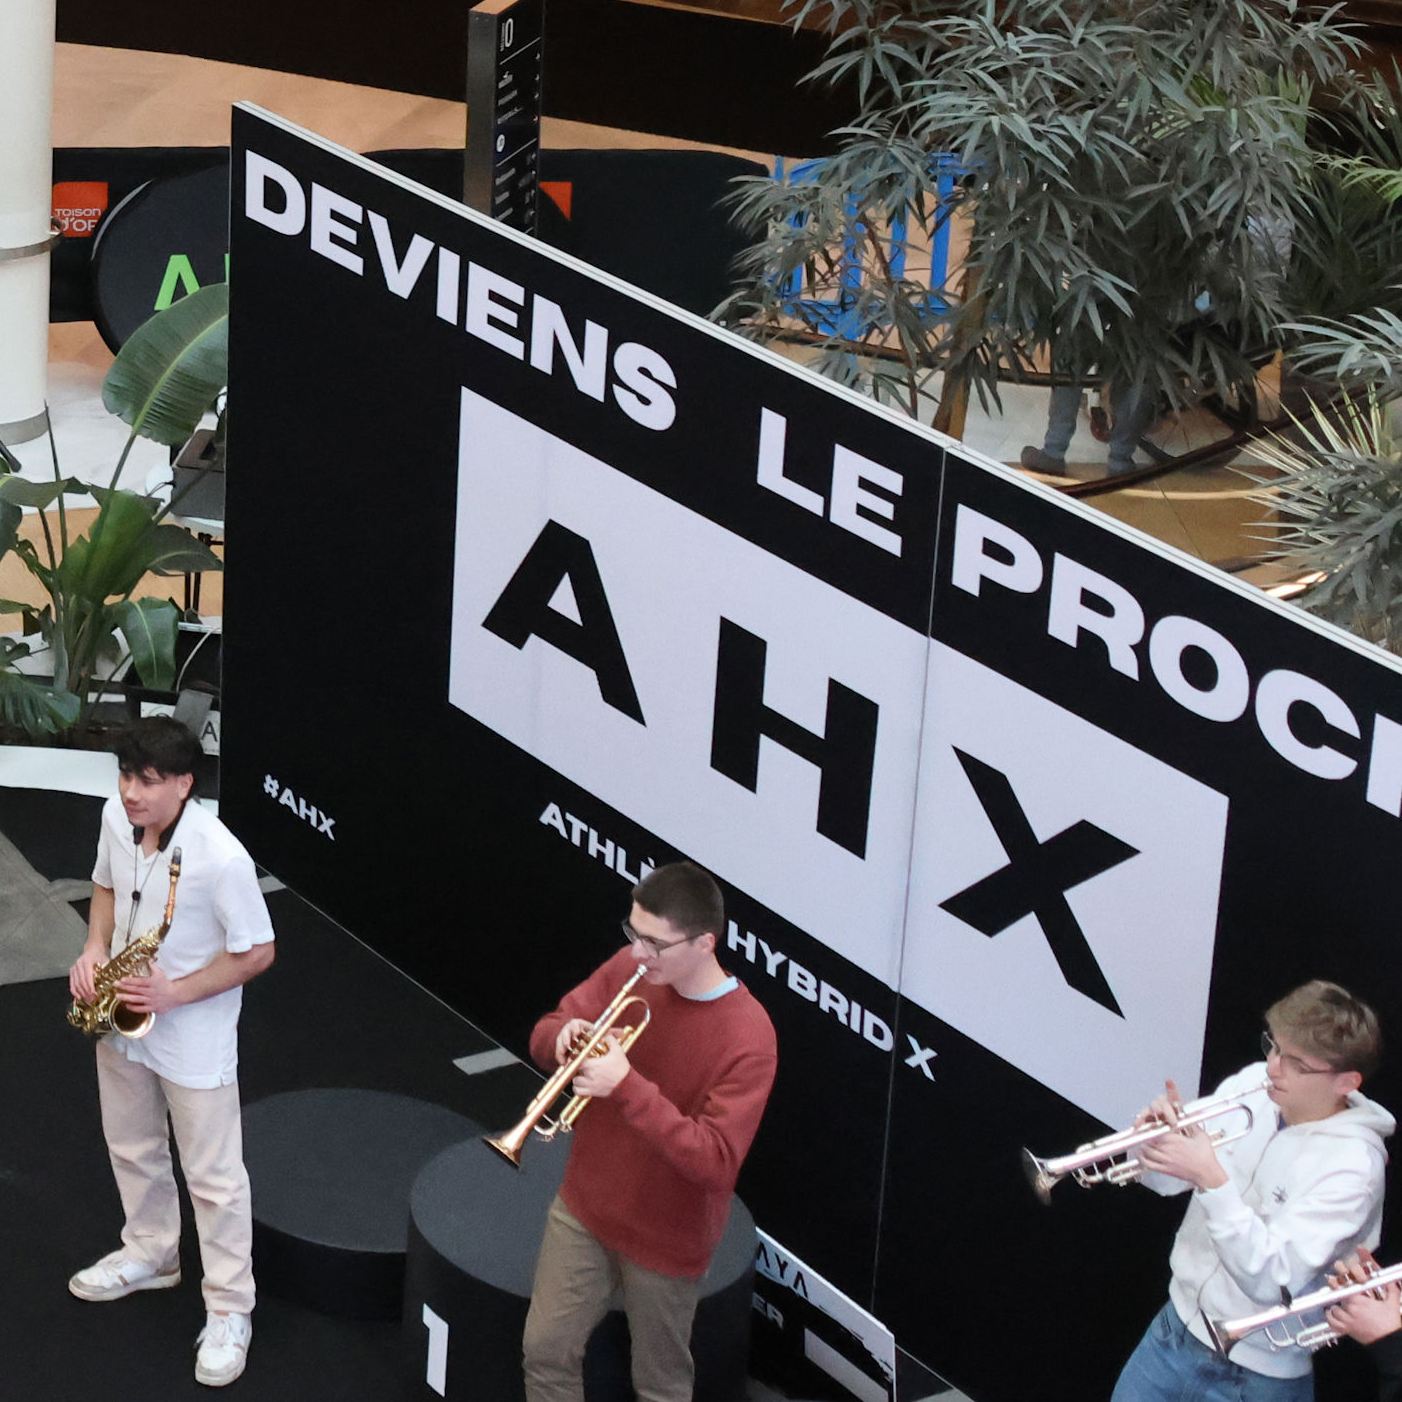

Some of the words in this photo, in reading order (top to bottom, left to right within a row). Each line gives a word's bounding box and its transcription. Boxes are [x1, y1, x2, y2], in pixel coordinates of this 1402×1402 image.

[243, 148, 679, 432] DEVIENS
[758, 404, 906, 559] LE
[262, 774, 337, 841] #AHX
[481, 517, 1142, 1021] AHX
[539, 801, 656, 886] ATHL
[728, 920, 895, 1053] HYBRID
[905, 1033, 939, 1083] X
